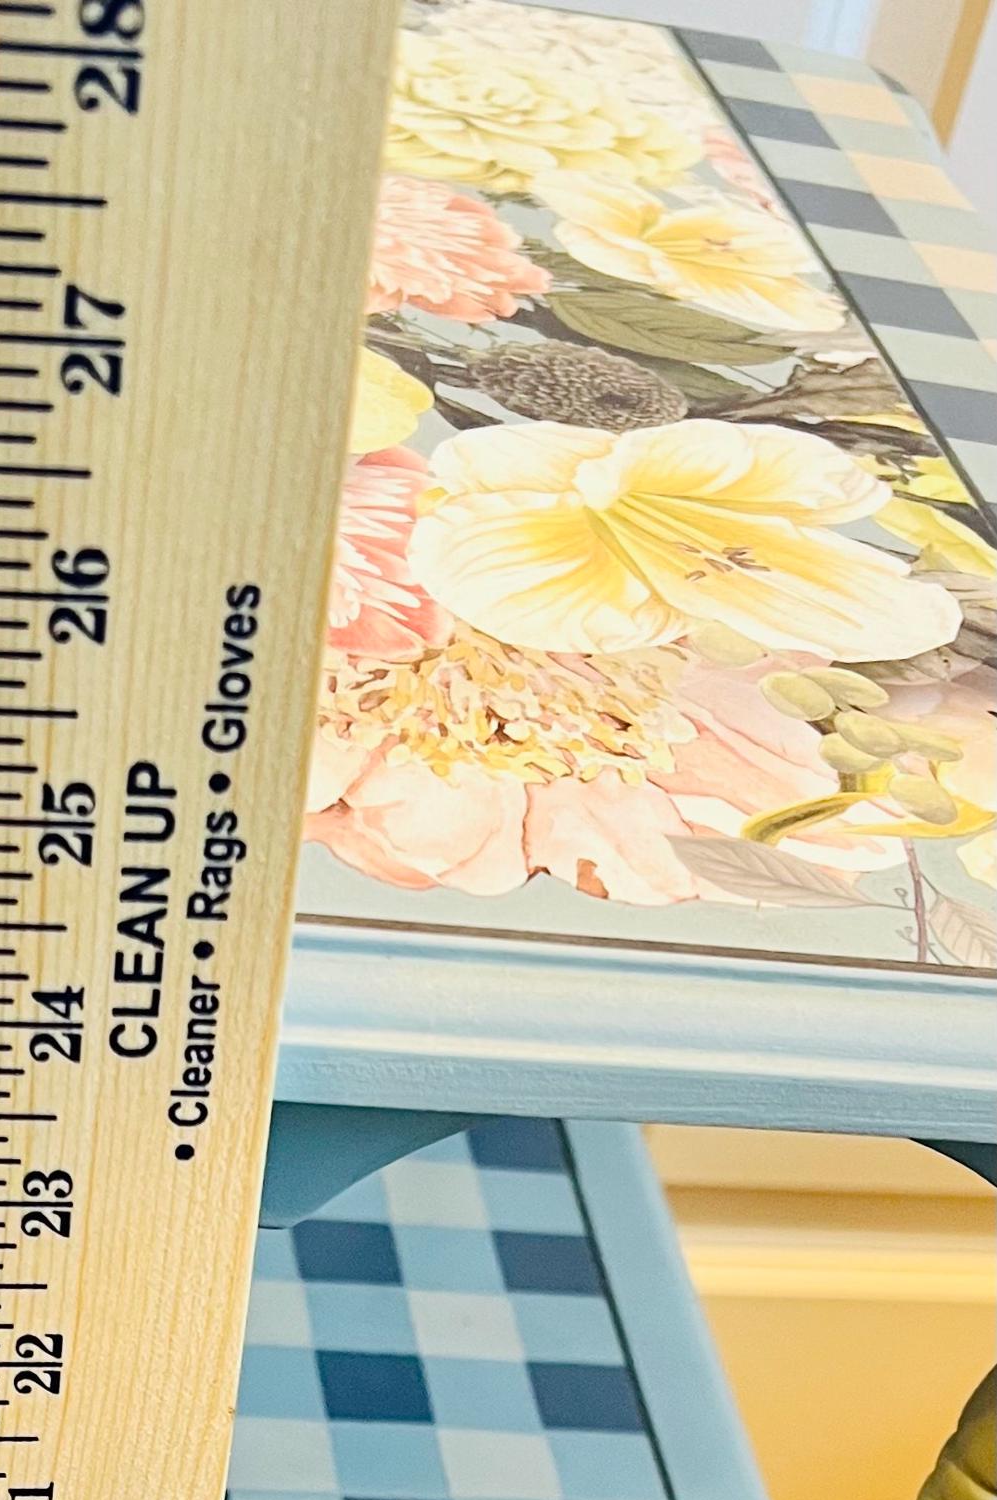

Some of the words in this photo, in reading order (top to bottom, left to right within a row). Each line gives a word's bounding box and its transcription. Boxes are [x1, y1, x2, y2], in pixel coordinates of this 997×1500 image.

[73, 0, 144, 116] 28
[61, 284, 125, 397] 27
[49, 548, 110, 645] 26
[202, 582, 261, 753] Gloves
[38, 781, 96, 867] 25
[123, 760, 177, 842] UP
[187, 811, 247, 921] Rags
[109, 867, 171, 1058] CLEAN
[30, 985, 84, 1063] 24
[168, 975, 220, 1127] Cleaner
[20, 1169, 73, 1238] 23
[13, 1333, 63, 1394] 22
